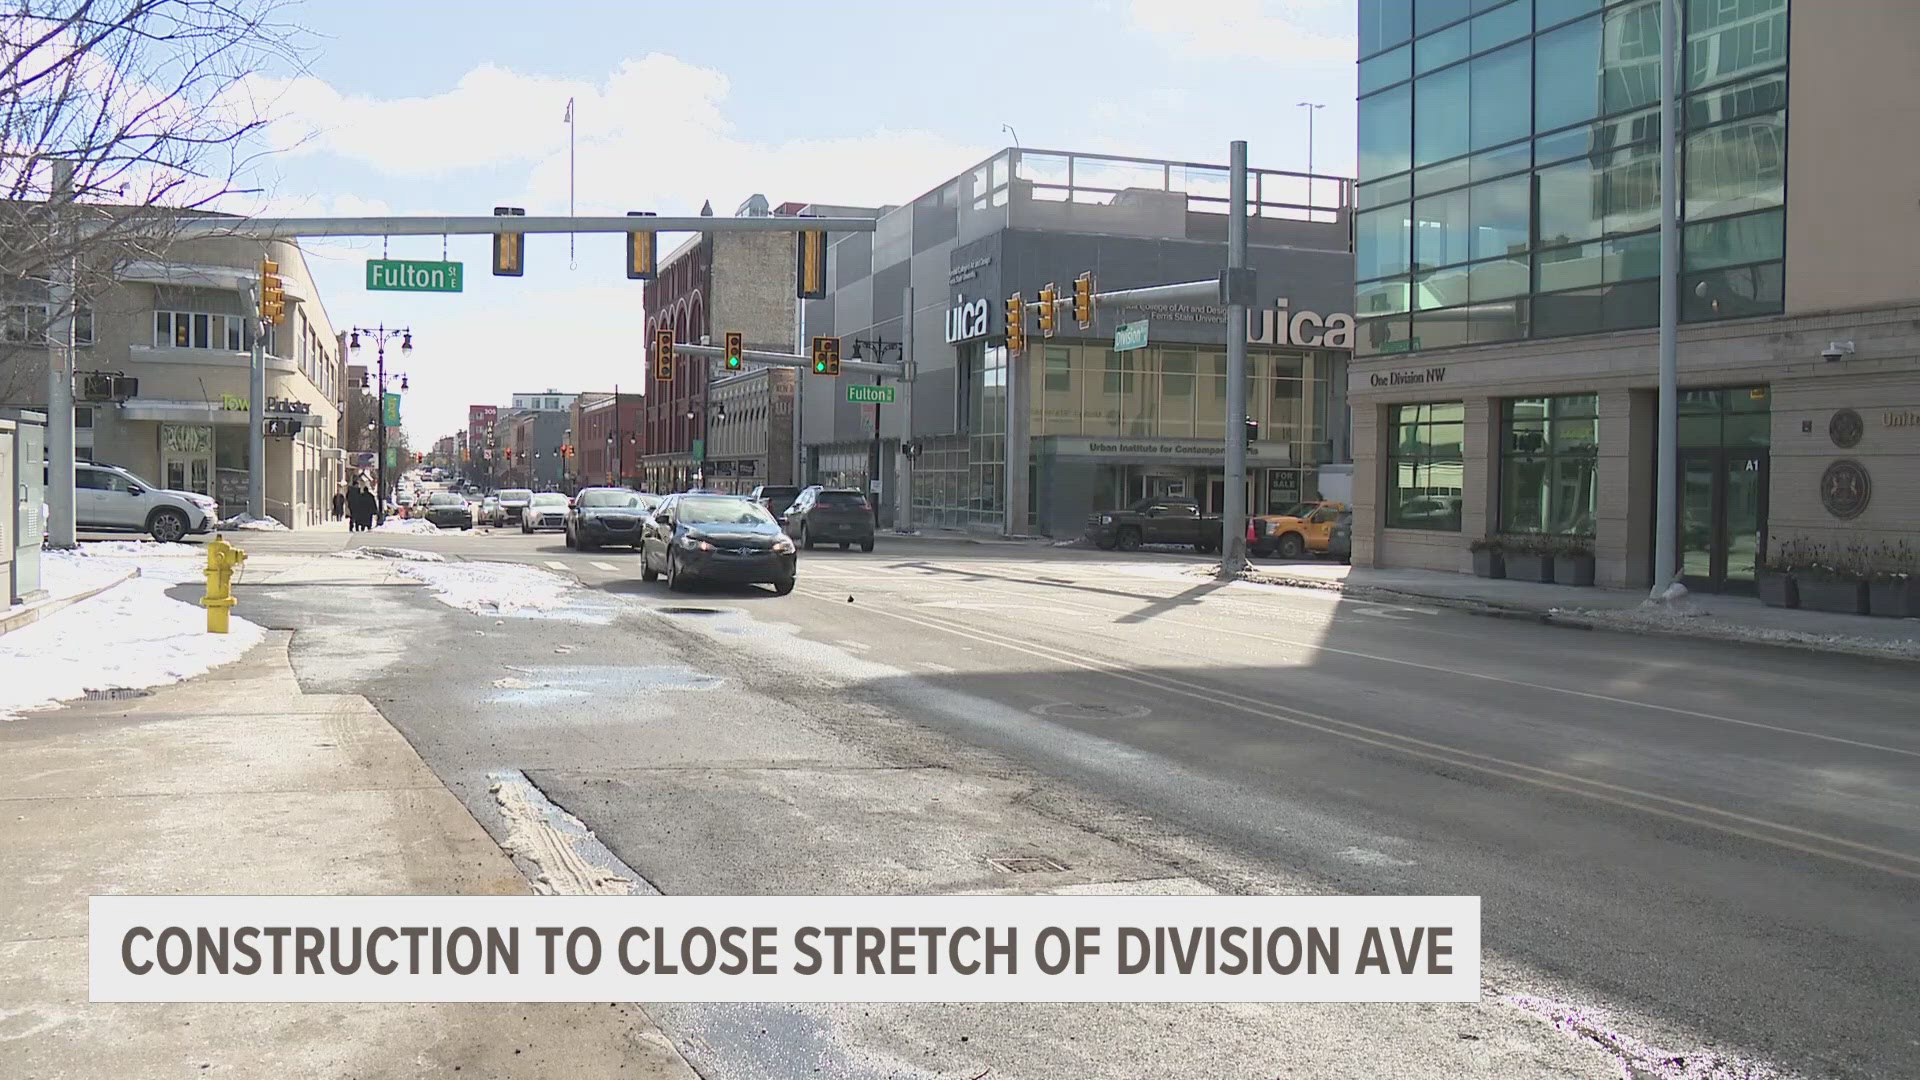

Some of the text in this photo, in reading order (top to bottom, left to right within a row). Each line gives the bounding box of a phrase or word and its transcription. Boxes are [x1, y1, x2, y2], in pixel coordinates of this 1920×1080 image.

[373, 264, 444, 288] Fulton
[448, 266, 456, 276] St
[451, 278, 456, 288] E
[1169, 304, 1177, 312] of
[1178, 304, 1190, 312] Art
[1191, 306, 1205, 314] and
[1206, 305, 1228, 316] Desig
[946, 294, 987, 343] uica
[1151, 311, 1173, 320] Ferris
[1175, 313, 1194, 322] State
[1246, 298, 1354, 348] uica
[1116, 328, 1141, 346] Division
[1370, 367, 1446, 386] One Division NW
[849, 387, 886, 400] Fulton
[221, 393, 250, 411] Tow
[1090, 443, 1117, 452] Urban
[1120, 444, 1158, 454] Institute
[1160, 445, 1173, 453] for
[1745, 459, 1759, 471] A1
[1275, 472, 1293, 480] FOR
